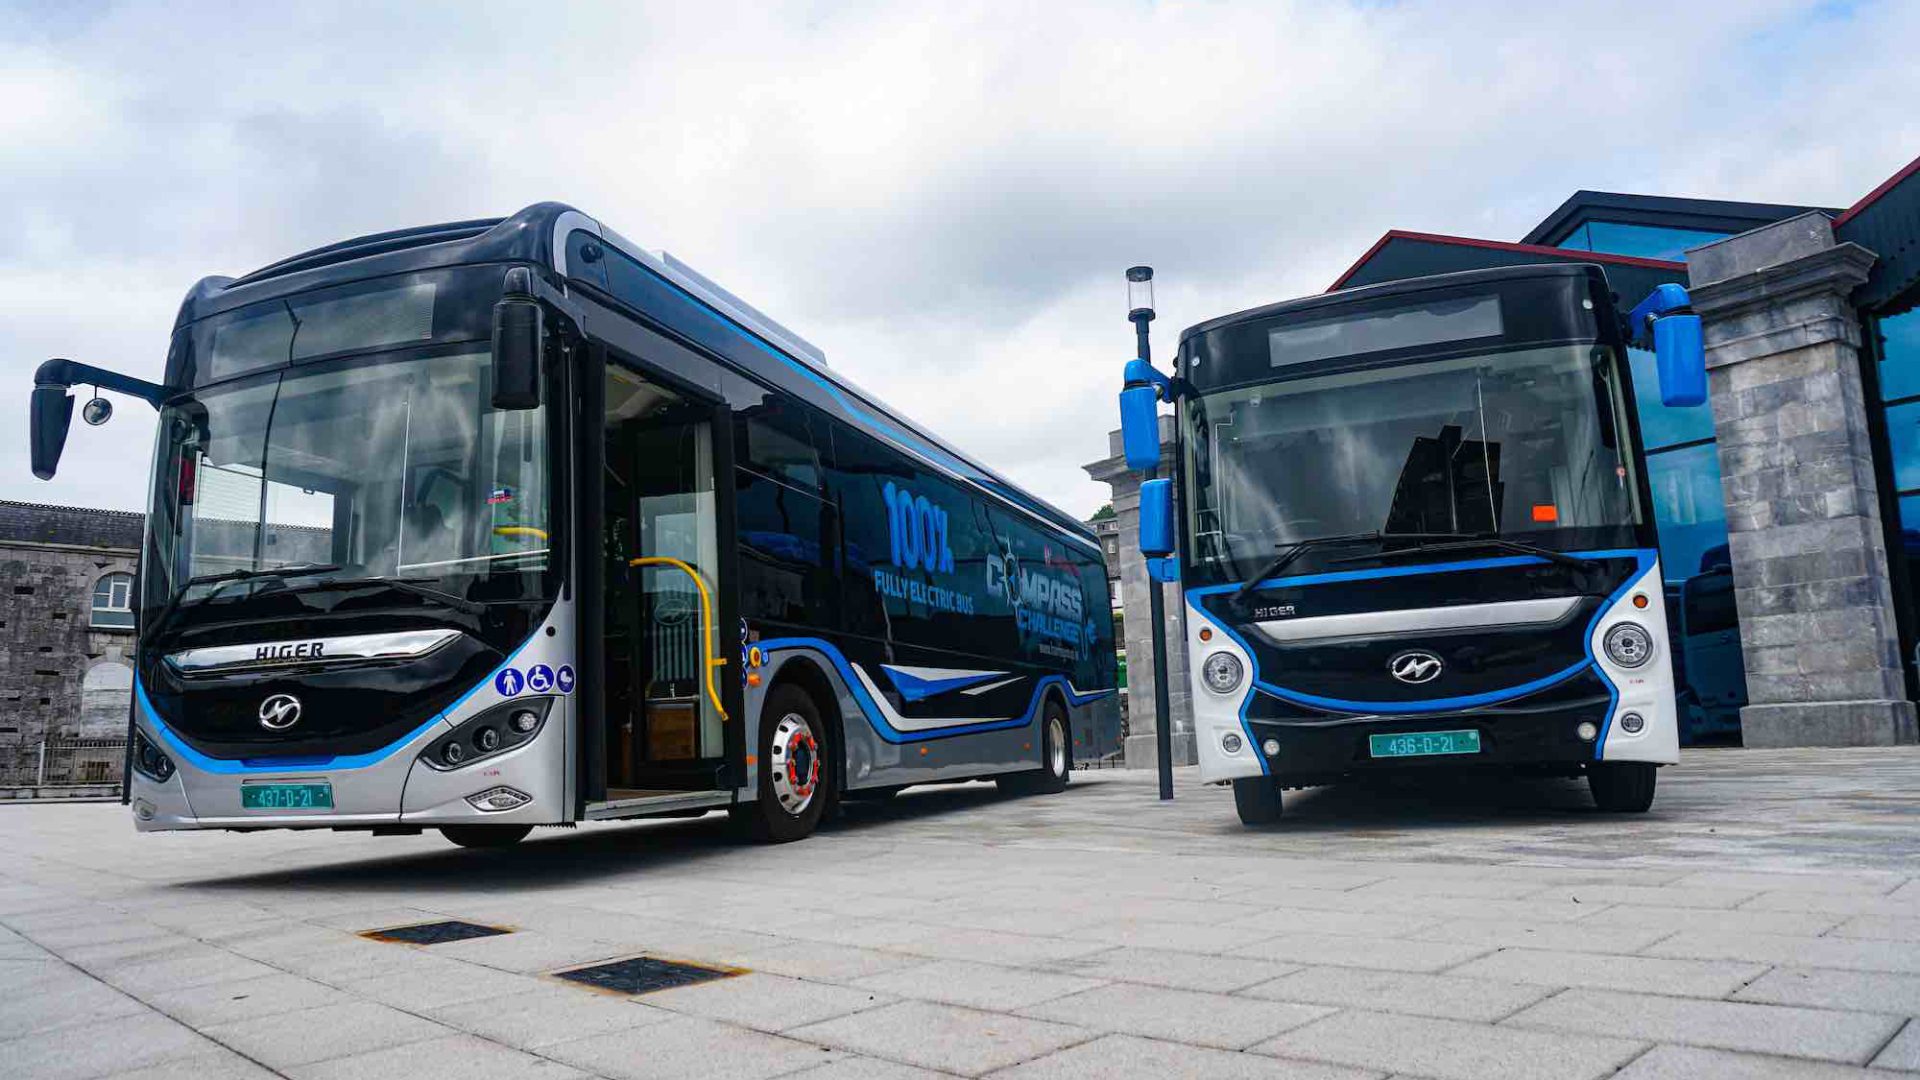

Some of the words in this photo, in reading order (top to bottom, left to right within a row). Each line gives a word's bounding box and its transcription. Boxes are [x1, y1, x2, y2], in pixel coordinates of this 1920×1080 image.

[883, 481, 954, 574] 100%
[874, 569, 908, 600] FULLY
[911, 580, 955, 611] ELECTRIC
[956, 592, 975, 615] BUS
[986, 552, 1083, 622] COMPASS
[1254, 605, 1296, 618] HIGER
[256, 642, 324, 661] HIGER
[1389, 736, 1454, 754] 436-D-21
[259, 789, 312, 807] 437-D-21
